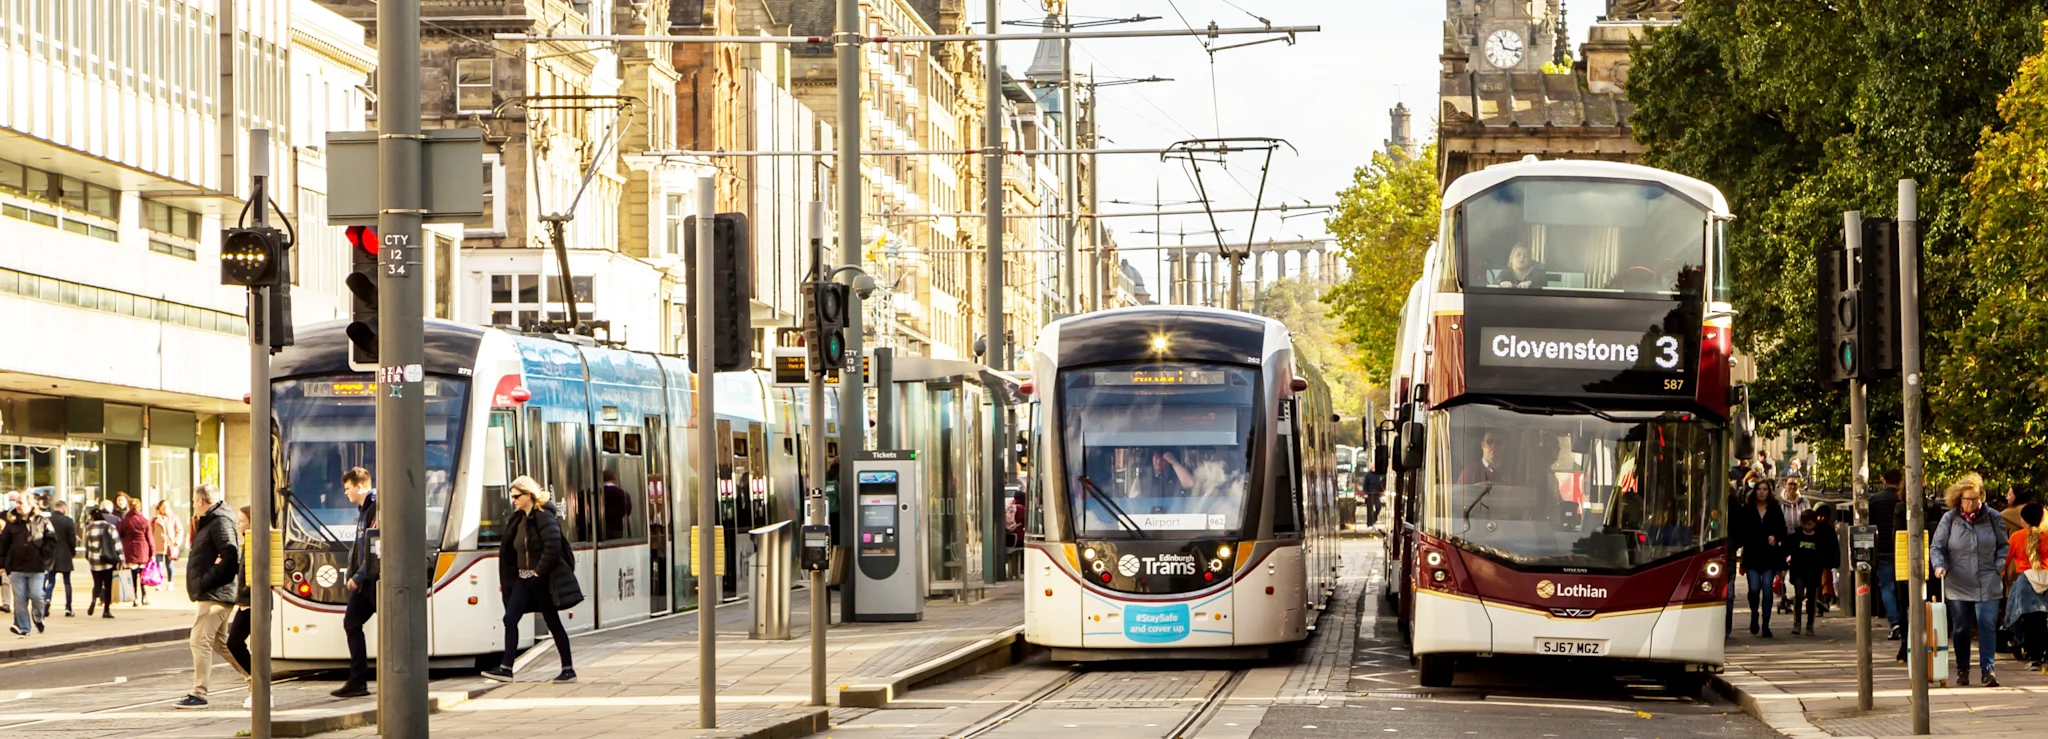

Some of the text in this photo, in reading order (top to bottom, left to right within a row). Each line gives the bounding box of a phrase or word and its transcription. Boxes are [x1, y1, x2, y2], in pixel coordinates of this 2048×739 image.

[384, 234, 409, 246] CTY
[390, 249, 403, 260] 12
[388, 264, 406, 275] 34
[1492, 334, 1680, 368] Clovenstone 3
[1247, 356, 1260, 364] 262
[458, 367, 472, 376] 272
[1663, 379, 1684, 390] 587
[1144, 517, 1181, 527] Airport
[1159, 554, 1195, 562] Edinburgh
[1142, 557, 1196, 575] Trams
[1556, 583, 1607, 598] Lothian
[1136, 613, 1178, 623] #StaySafe
[1130, 625, 1146, 633] and
[1173, 625, 1184, 633] up
[1544, 641, 1599, 654] SJ67 MGZ
